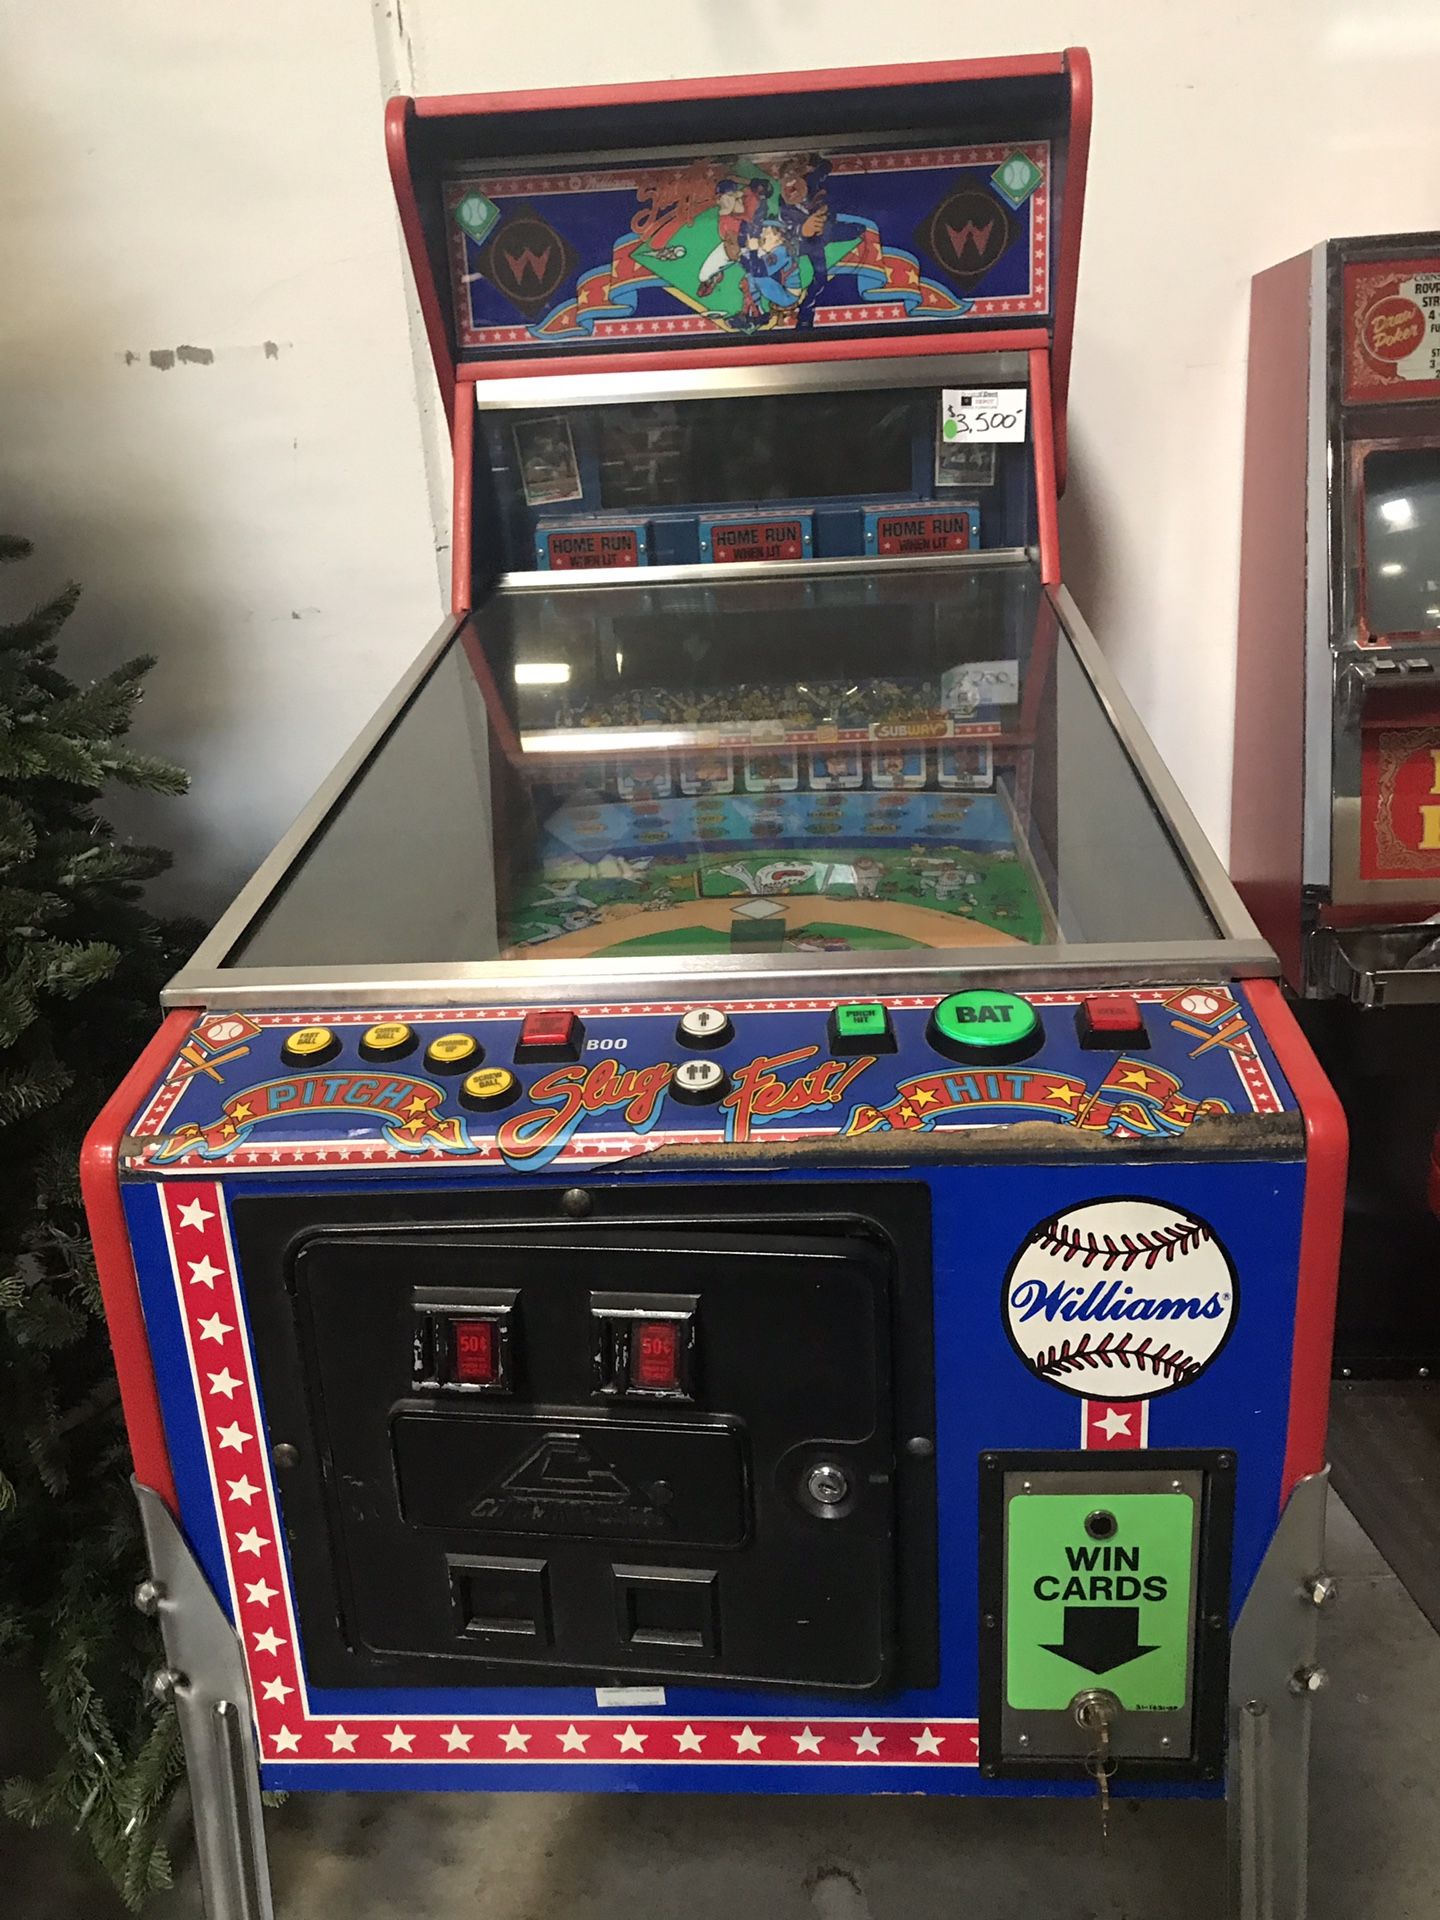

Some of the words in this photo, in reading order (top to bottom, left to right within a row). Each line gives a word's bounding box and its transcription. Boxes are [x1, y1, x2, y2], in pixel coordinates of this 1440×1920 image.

[1371, 306, 1417, 333] Draw
[1373, 324, 1418, 352] Poker
[717, 529, 758, 546] HOME
[765, 527, 796, 542] RUN
[883, 521, 925, 537] HOME
[932, 518, 963, 533] RUN
[553, 538, 595, 553] HOME
[601, 536, 631, 550] RUN
[878, 722, 938, 737] SUBWAY
[955, 1005, 1014, 1023] BAT
[586, 1038, 628, 1050] BOO
[472, 1072, 503, 1082] SCREW
[479, 1079, 501, 1088] BALL
[267, 1079, 414, 1111] PITCH
[944, 1074, 1033, 1102] HIT
[497, 1058, 676, 1161] Slug
[1064, 1546, 1140, 1571] WIN
[1033, 1575, 1168, 1601] CARDS
